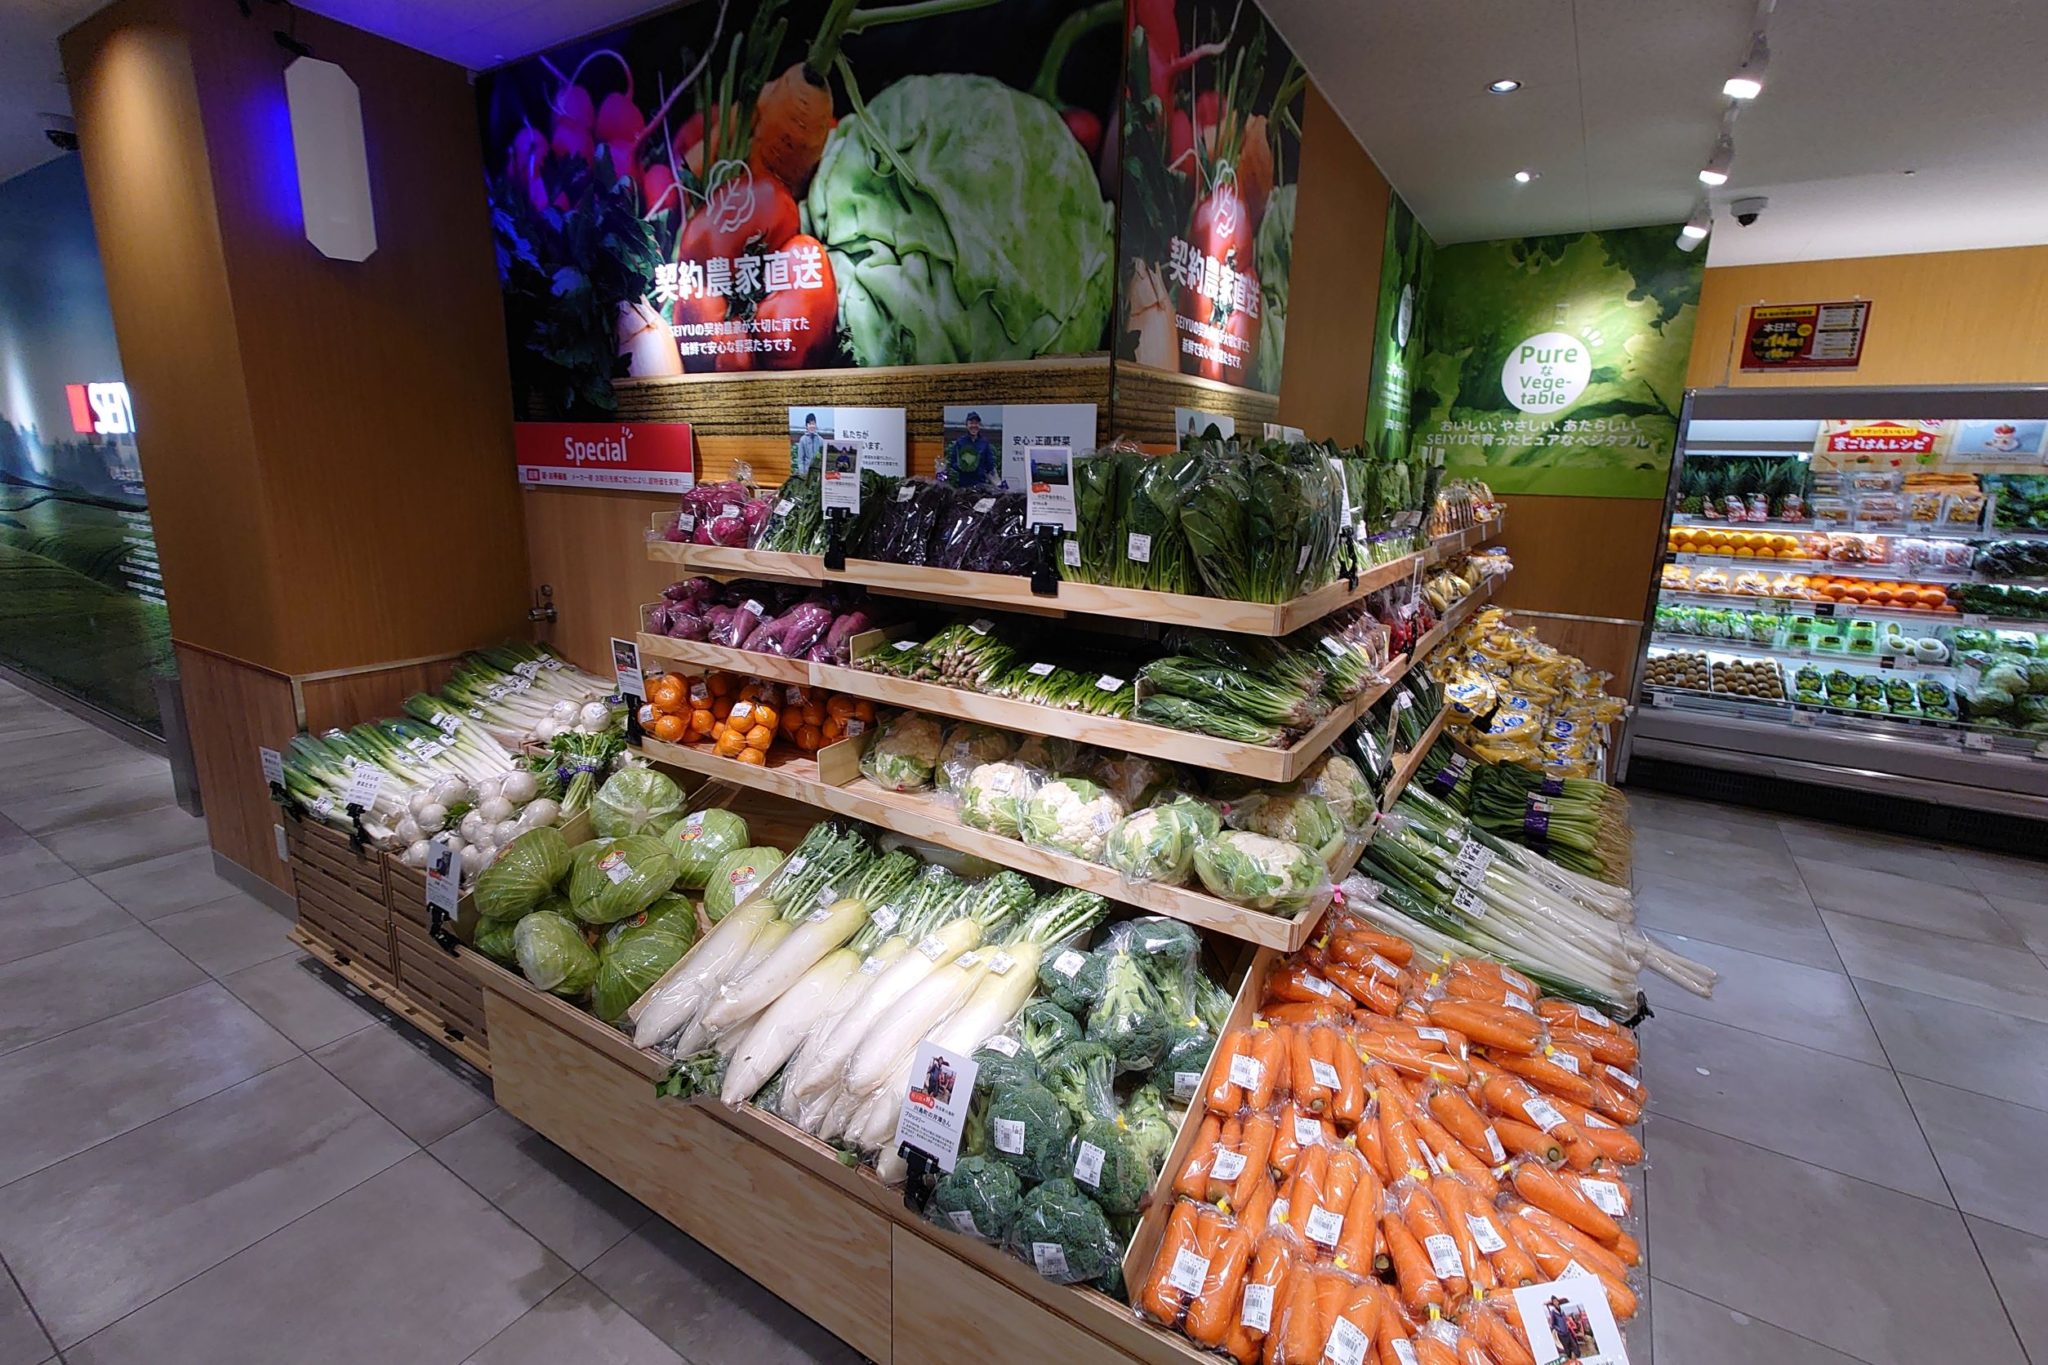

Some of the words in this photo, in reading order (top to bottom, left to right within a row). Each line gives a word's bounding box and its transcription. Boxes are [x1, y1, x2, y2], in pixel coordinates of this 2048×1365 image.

[655, 246, 823, 303] 契約農家直送
[1169, 235, 1260, 319] 契約農家直送
[669, 317, 810, 338] SEIYUの契約農家が大切に育てた
[680, 338, 797, 357] 新鮮で安心な野菜たちです。
[1520, 346, 1578, 364] Pure
[1540, 366, 1553, 376] な
[1520, 376, 1572, 392] Vege-
[1520, 391, 1566, 405] table
[564, 437, 627, 466] Special
[1834, 436, 1931, 450] 家ごはんレシピ
